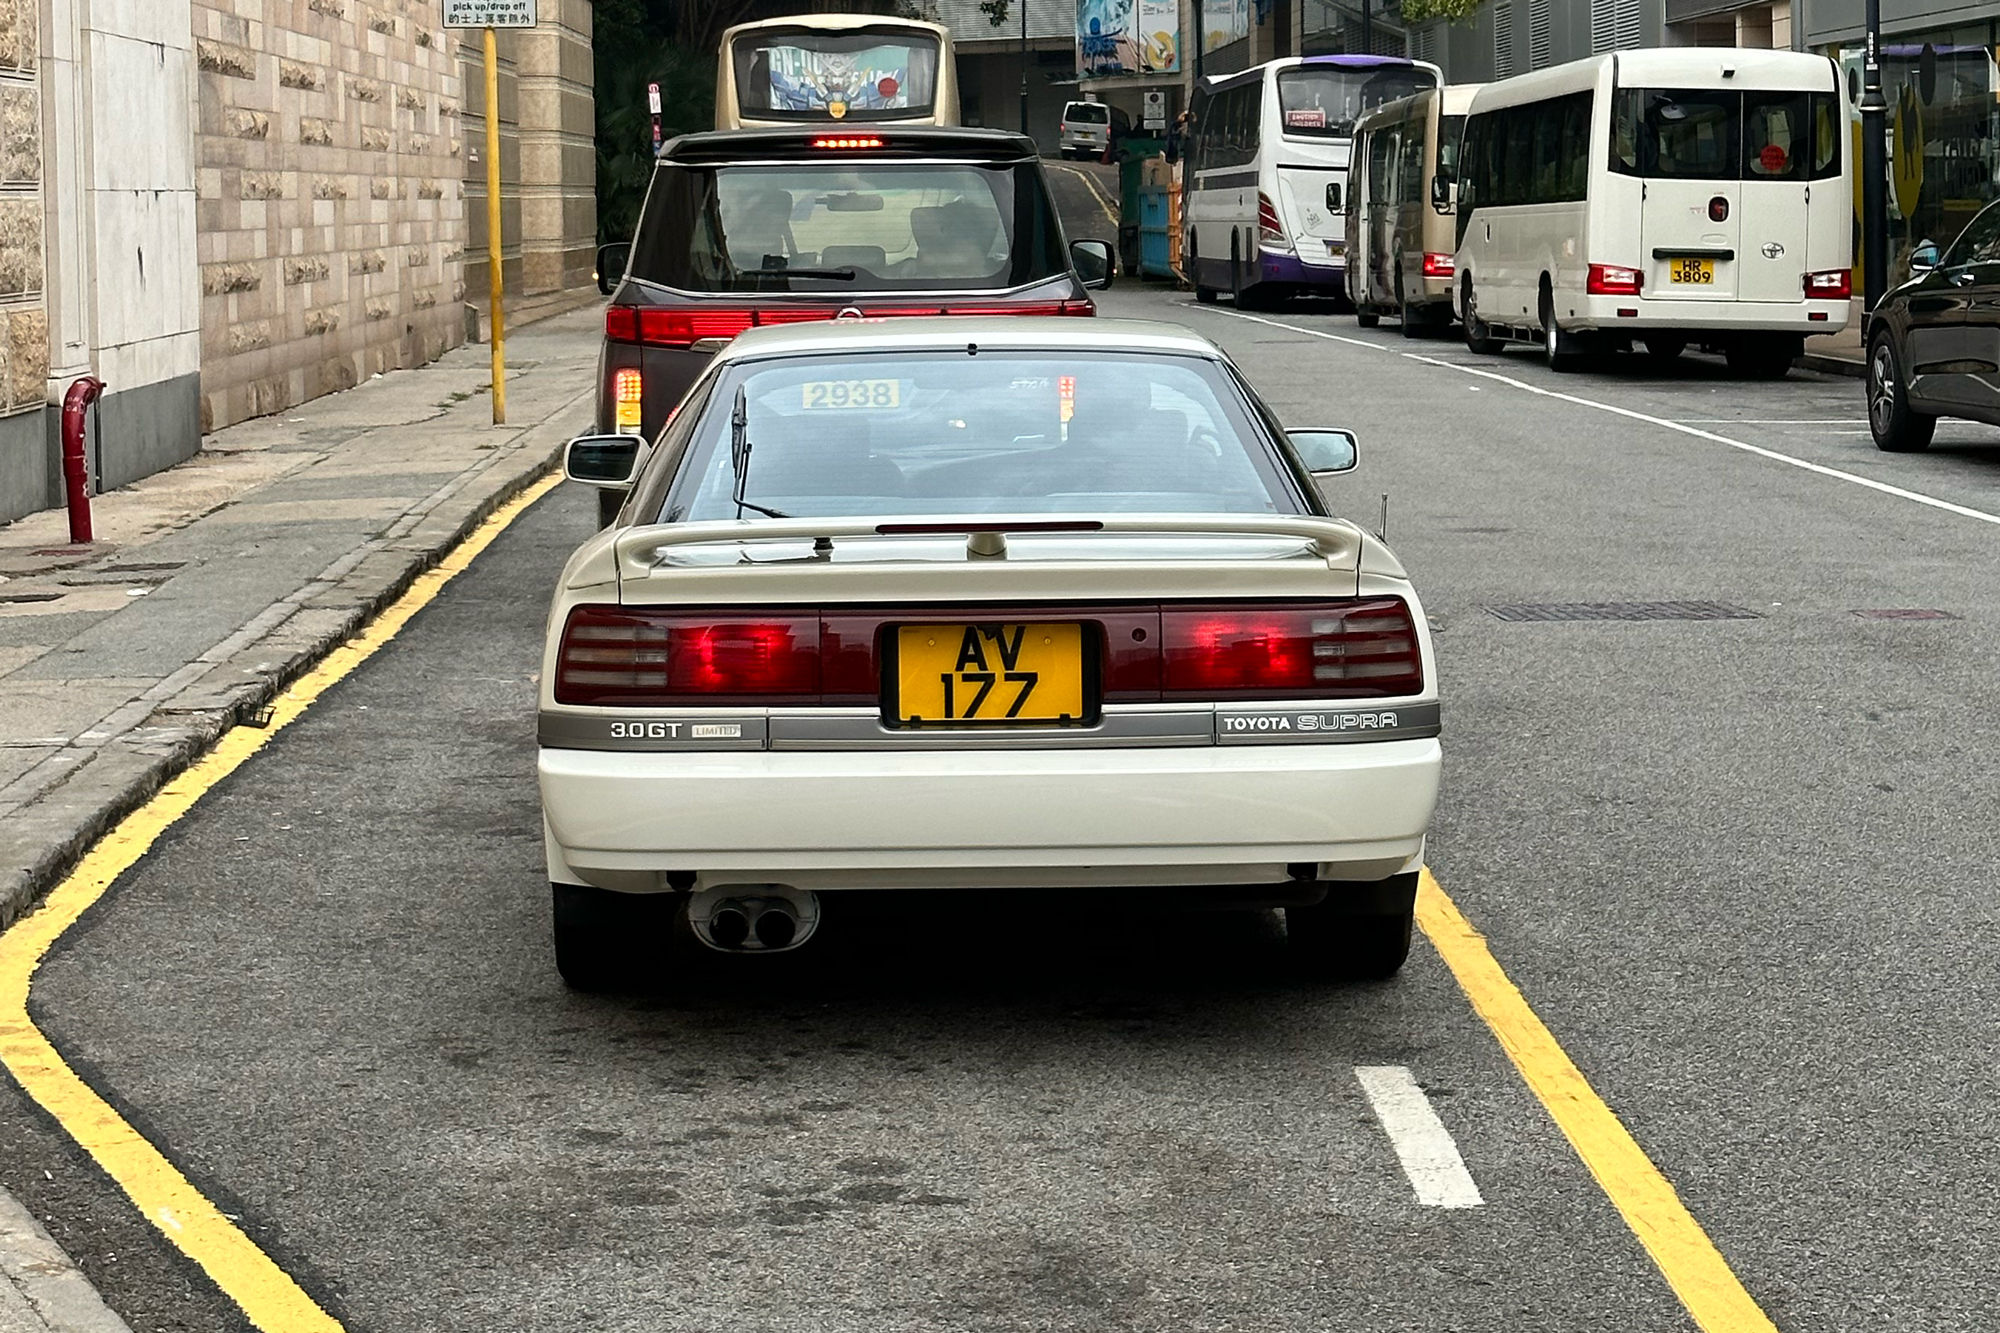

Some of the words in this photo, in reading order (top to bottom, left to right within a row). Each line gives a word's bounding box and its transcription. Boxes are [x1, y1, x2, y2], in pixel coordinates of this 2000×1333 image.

[453, 2, 472, 12] pick
[475, 2, 511, 12] up/drop
[513, 2, 526, 11] off
[1682, 260, 1702, 271] HR
[1673, 271, 1711, 283] 3809
[810, 382, 892, 408] 2938
[955, 625, 1026, 672] AV
[941, 672, 1039, 719] 177
[1224, 717, 1291, 730] TOYOTA
[1297, 712, 1398, 730] SUPRA
[693, 725, 739, 736] LIMITED
